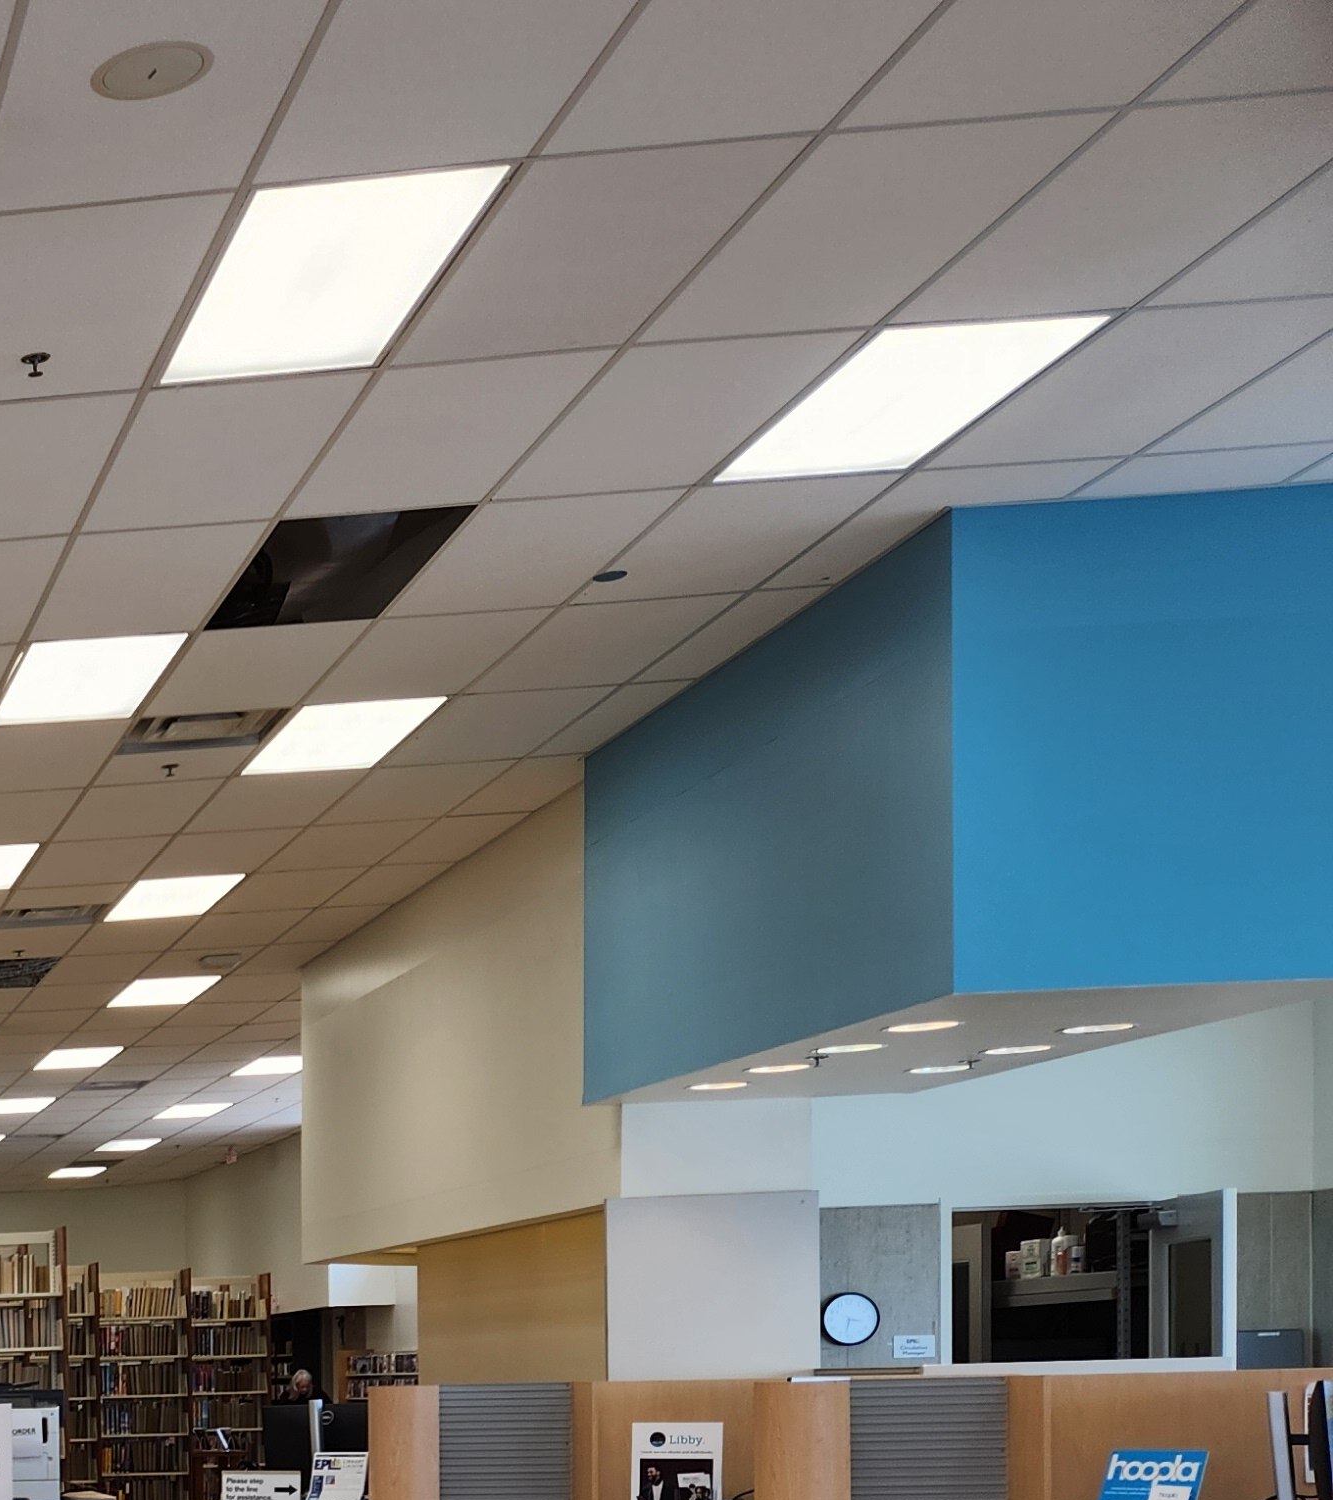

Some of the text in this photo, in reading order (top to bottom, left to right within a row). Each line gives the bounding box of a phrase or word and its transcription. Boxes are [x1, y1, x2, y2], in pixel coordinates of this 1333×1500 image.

[12, 1428, 36, 1436] ORDER
[314, 1458, 341, 1470] EPL
[1107, 1454, 1201, 1484] hoopla
